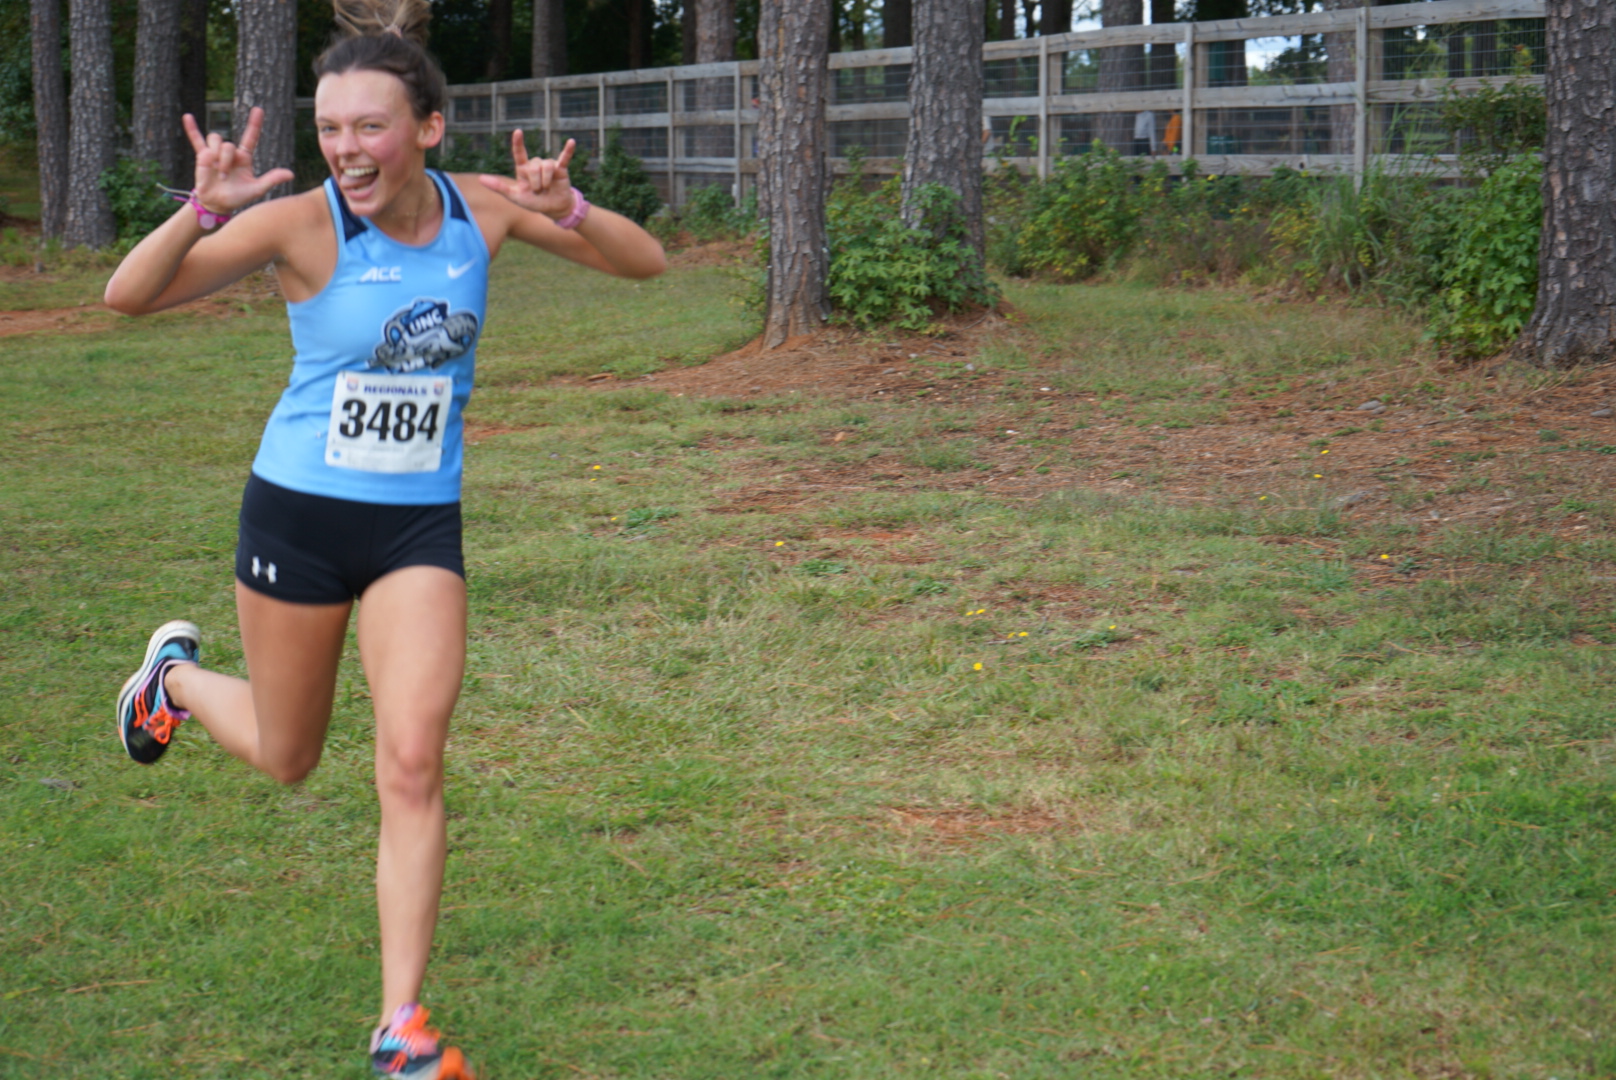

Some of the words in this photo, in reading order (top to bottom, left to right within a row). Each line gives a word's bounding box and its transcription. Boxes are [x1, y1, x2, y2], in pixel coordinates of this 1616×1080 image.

[409, 308, 443, 333] UNC
[364, 384, 428, 396] REGIONALS
[338, 399, 440, 443] 3484
